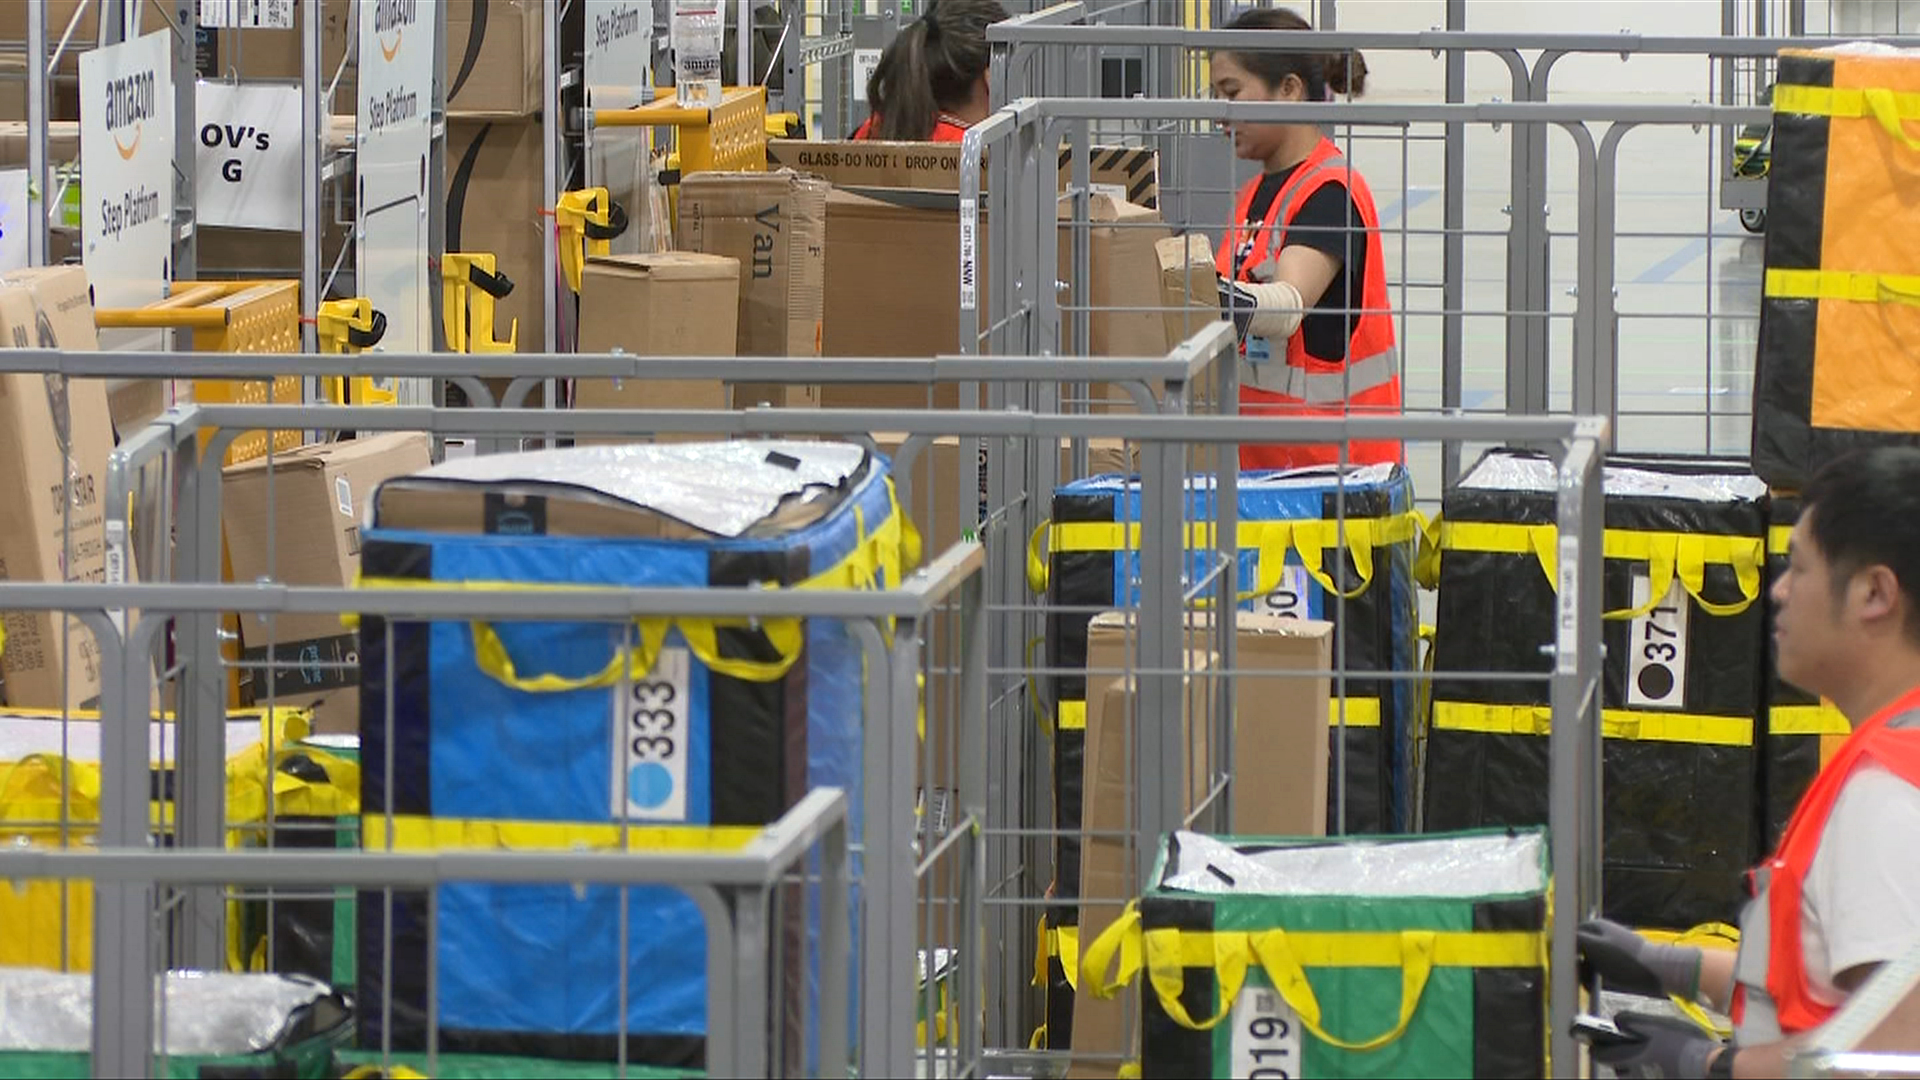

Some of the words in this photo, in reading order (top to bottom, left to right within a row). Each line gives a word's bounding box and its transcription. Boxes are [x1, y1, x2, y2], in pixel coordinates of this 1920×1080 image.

[596, 14, 610, 51] Step
[611, 3, 638, 40] Platform
[105, 69, 155, 131] amazon
[369, 96, 385, 136] Step
[386, 84, 417, 125] Platform
[200, 123, 270, 151] OV's
[865, 154, 888, 168] NOT
[905, 156, 937, 170] DROP
[222, 159, 243, 182] G
[101, 199, 123, 241] Step
[124, 185, 159, 230] Platform
[753, 204, 780, 280] Van
[1643, 607, 1678, 662] 371
[632, 682, 676, 759] 333
